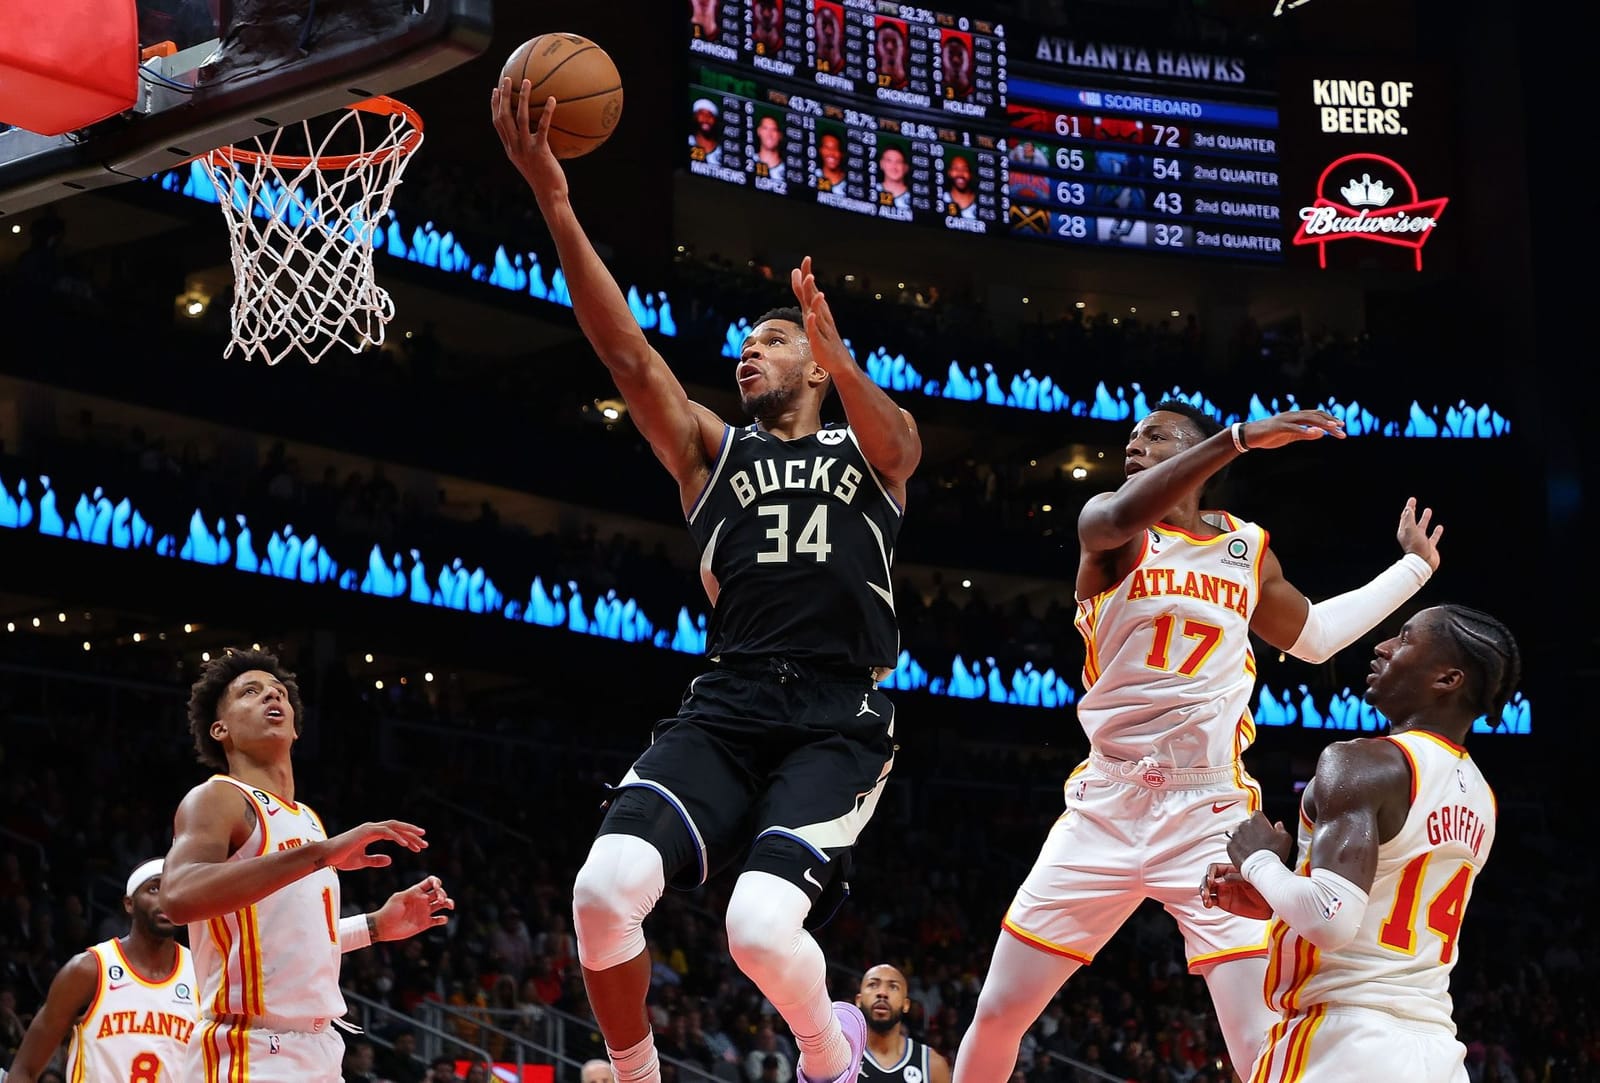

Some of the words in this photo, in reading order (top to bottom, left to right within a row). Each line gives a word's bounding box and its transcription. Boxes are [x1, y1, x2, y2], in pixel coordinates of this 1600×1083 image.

[744, 10, 753, 22] 2
[866, 30, 875, 41] 4
[994, 24, 1004, 37] 4
[690, 38, 738, 61] JOHNSON
[744, 38, 753, 50] 2
[997, 41, 1006, 52] 4
[753, 54, 795, 76] HOLIDAY
[933, 56, 941, 68] 2
[1036, 36, 1152, 73] ATLANTA
[1157, 51, 1246, 83] HAWKS
[815, 72, 854, 91] GRIFFIN
[998, 68, 1007, 80] 2
[1000, 95, 1006, 108] 1
[1313, 79, 1375, 107] KING
[1381, 81, 1413, 107] OF
[745, 101, 754, 114] 6
[943, 99, 986, 117] HOLIDAY
[1105, 93, 1202, 117] SCOREBOARD
[746, 116, 753, 128] 1
[802, 116, 815, 130] 11
[1321, 107, 1408, 135] BEERS.
[746, 130, 753, 143] 1
[808, 131, 815, 144] 1
[962, 132, 971, 147] 1
[996, 138, 1007, 152] 4
[1055, 114, 1081, 138] 61
[1152, 125, 1180, 148] 72
[1194, 133, 1215, 147] 3rd
[1217, 135, 1275, 153] QUARTER
[868, 147, 876, 160] 7
[745, 160, 754, 172] 2
[808, 160, 816, 173] 2
[868, 161, 877, 174] 2
[1000, 156, 1009, 169] 2
[1056, 148, 1085, 171] 65
[1153, 158, 1181, 181] 54
[1194, 165, 1218, 180] 2nd
[1220, 168, 1278, 186] QUARTER
[691, 160, 747, 184] MATTHEWS
[935, 172, 944, 185] 3
[1001, 169, 1009, 182] 3
[755, 176, 788, 195] LOPEZ
[808, 175, 816, 187] 2
[870, 175, 876, 187] 1
[1000, 183, 1009, 196] 4
[936, 200, 944, 213] 3
[1057, 181, 1085, 205] 63
[1153, 192, 1182, 215] 43
[1195, 199, 1219, 213] 2nd
[1221, 201, 1280, 220] QUARTER
[879, 205, 913, 222] ALLEN
[1003, 211, 1010, 224] 1
[1299, 206, 1437, 234] Budweiser
[945, 215, 986, 234] CARTER
[1058, 214, 1086, 238] 28
[1154, 224, 1183, 247] 32
[1196, 232, 1220, 246] 2nd
[1222, 233, 1281, 251] QUARTER
[729, 456, 863, 509] BUCKS
[757, 504, 832, 563] 34
[1127, 568, 1249, 620] ATLANTA
[1144, 612, 1224, 679] 17
[1426, 805, 1486, 858] GRIFFIN
[321, 886, 337, 945] 1
[1378, 851, 1473, 966] 14
[130, 1050, 164, 1083] 8
